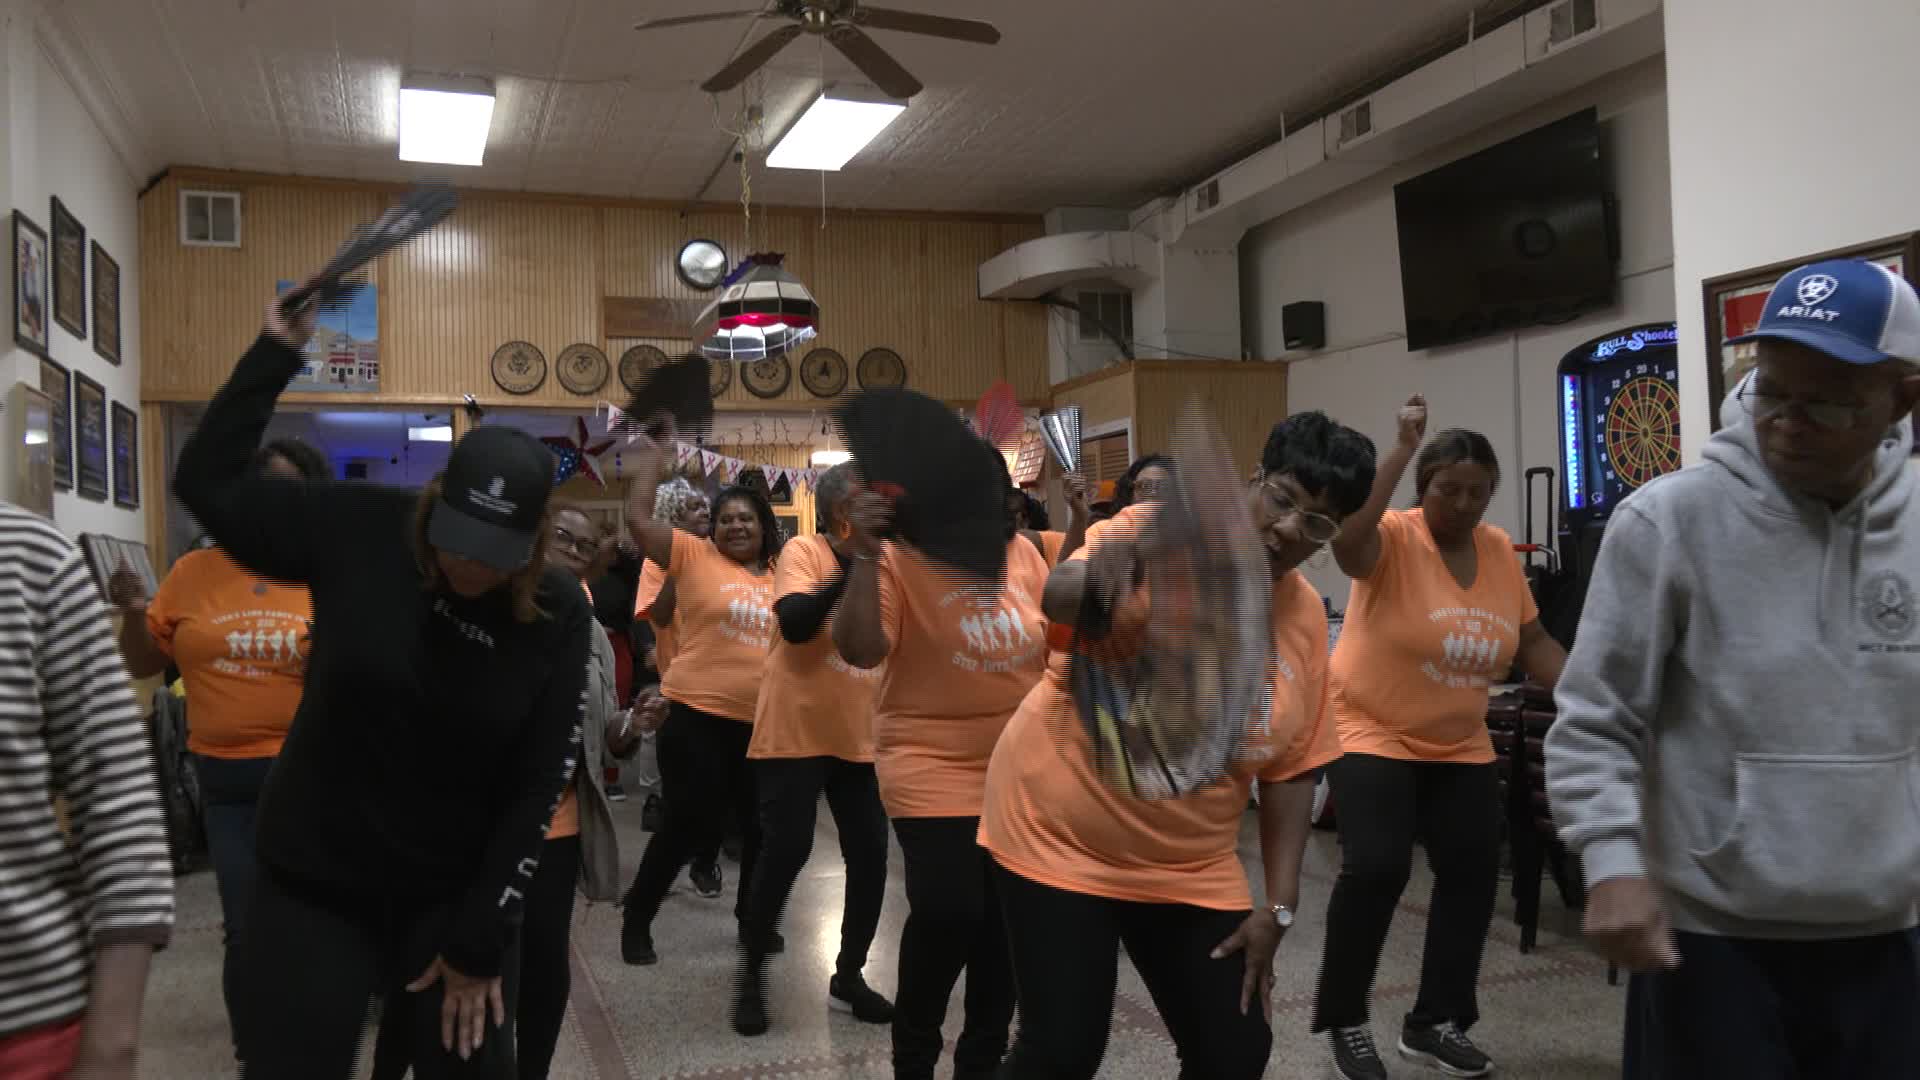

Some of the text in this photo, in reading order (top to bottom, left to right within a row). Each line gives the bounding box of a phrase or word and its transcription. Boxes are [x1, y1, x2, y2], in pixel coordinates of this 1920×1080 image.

[1776, 306, 1840, 321] ARIAT
[1625, 369, 1631, 379] 5
[1604, 396, 1610, 406] 9
